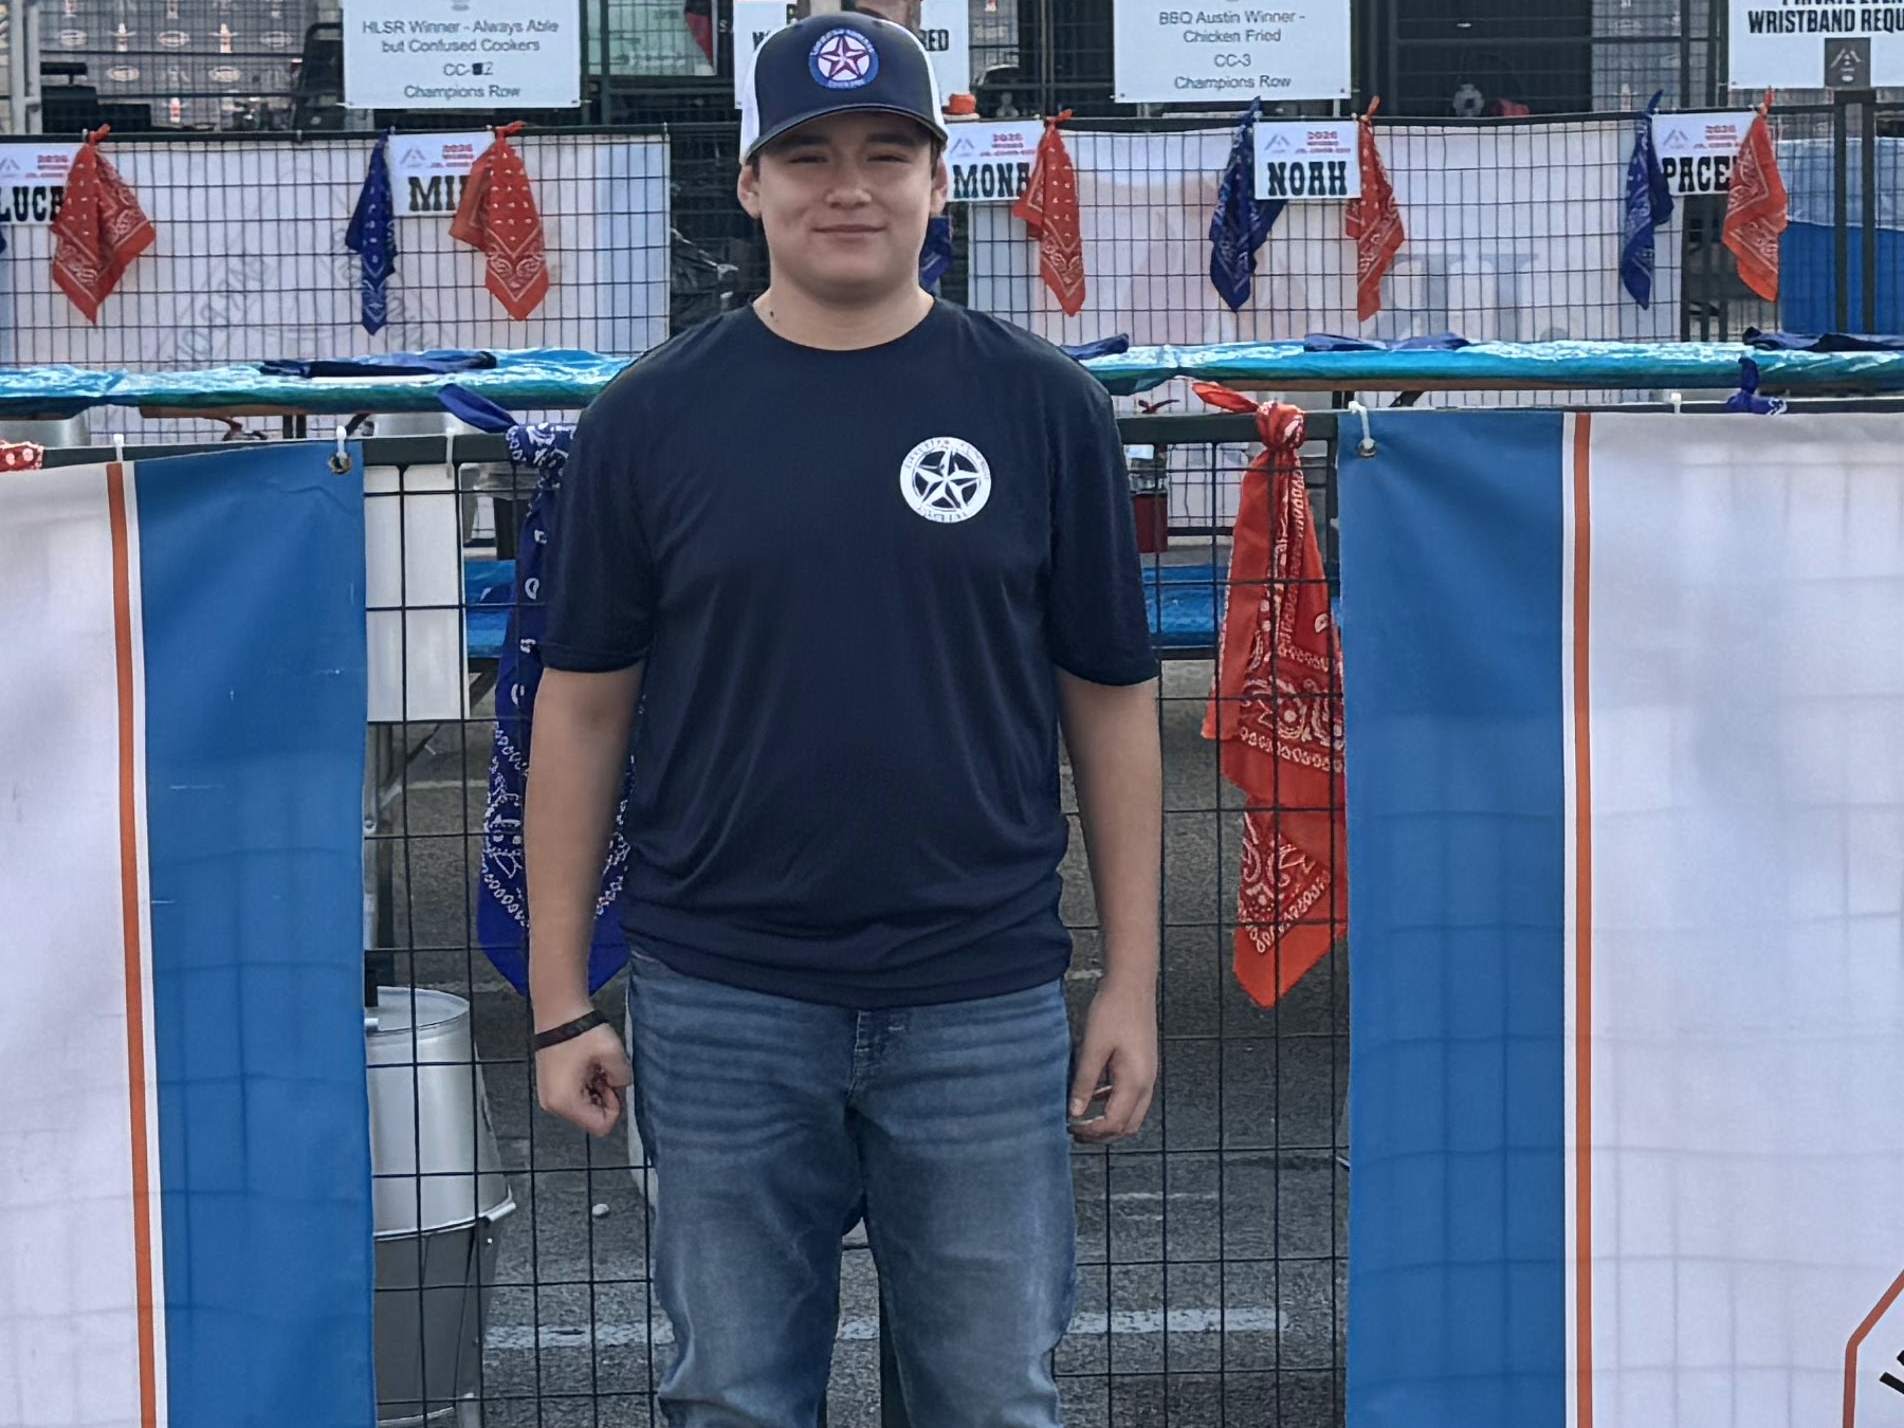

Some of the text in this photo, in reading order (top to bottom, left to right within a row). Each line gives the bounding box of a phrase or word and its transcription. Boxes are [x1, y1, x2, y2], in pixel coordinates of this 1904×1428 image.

[1159, 11, 1193, 25] BBQ
[1196, 11, 1241, 24] Austin
[1245, 10, 1297, 23] Winner
[1748, 9, 1856, 34] WRISTBAND
[362, 20, 405, 34] HLSR
[409, 21, 461, 34] Winner
[472, 19, 524, 37] Always
[526, 19, 560, 33] Able
[1183, 28, 1282, 43] Chicken Fried
[381, 36, 541, 54] but Confused Cookers
[1214, 53, 1252, 68] CC-3
[1174, 74, 1292, 91] Champions Row
[403, 84, 522, 101] Champions Row
[1267, 160, 1348, 197] NOAH
[1662, 155, 1738, 192] PACE
